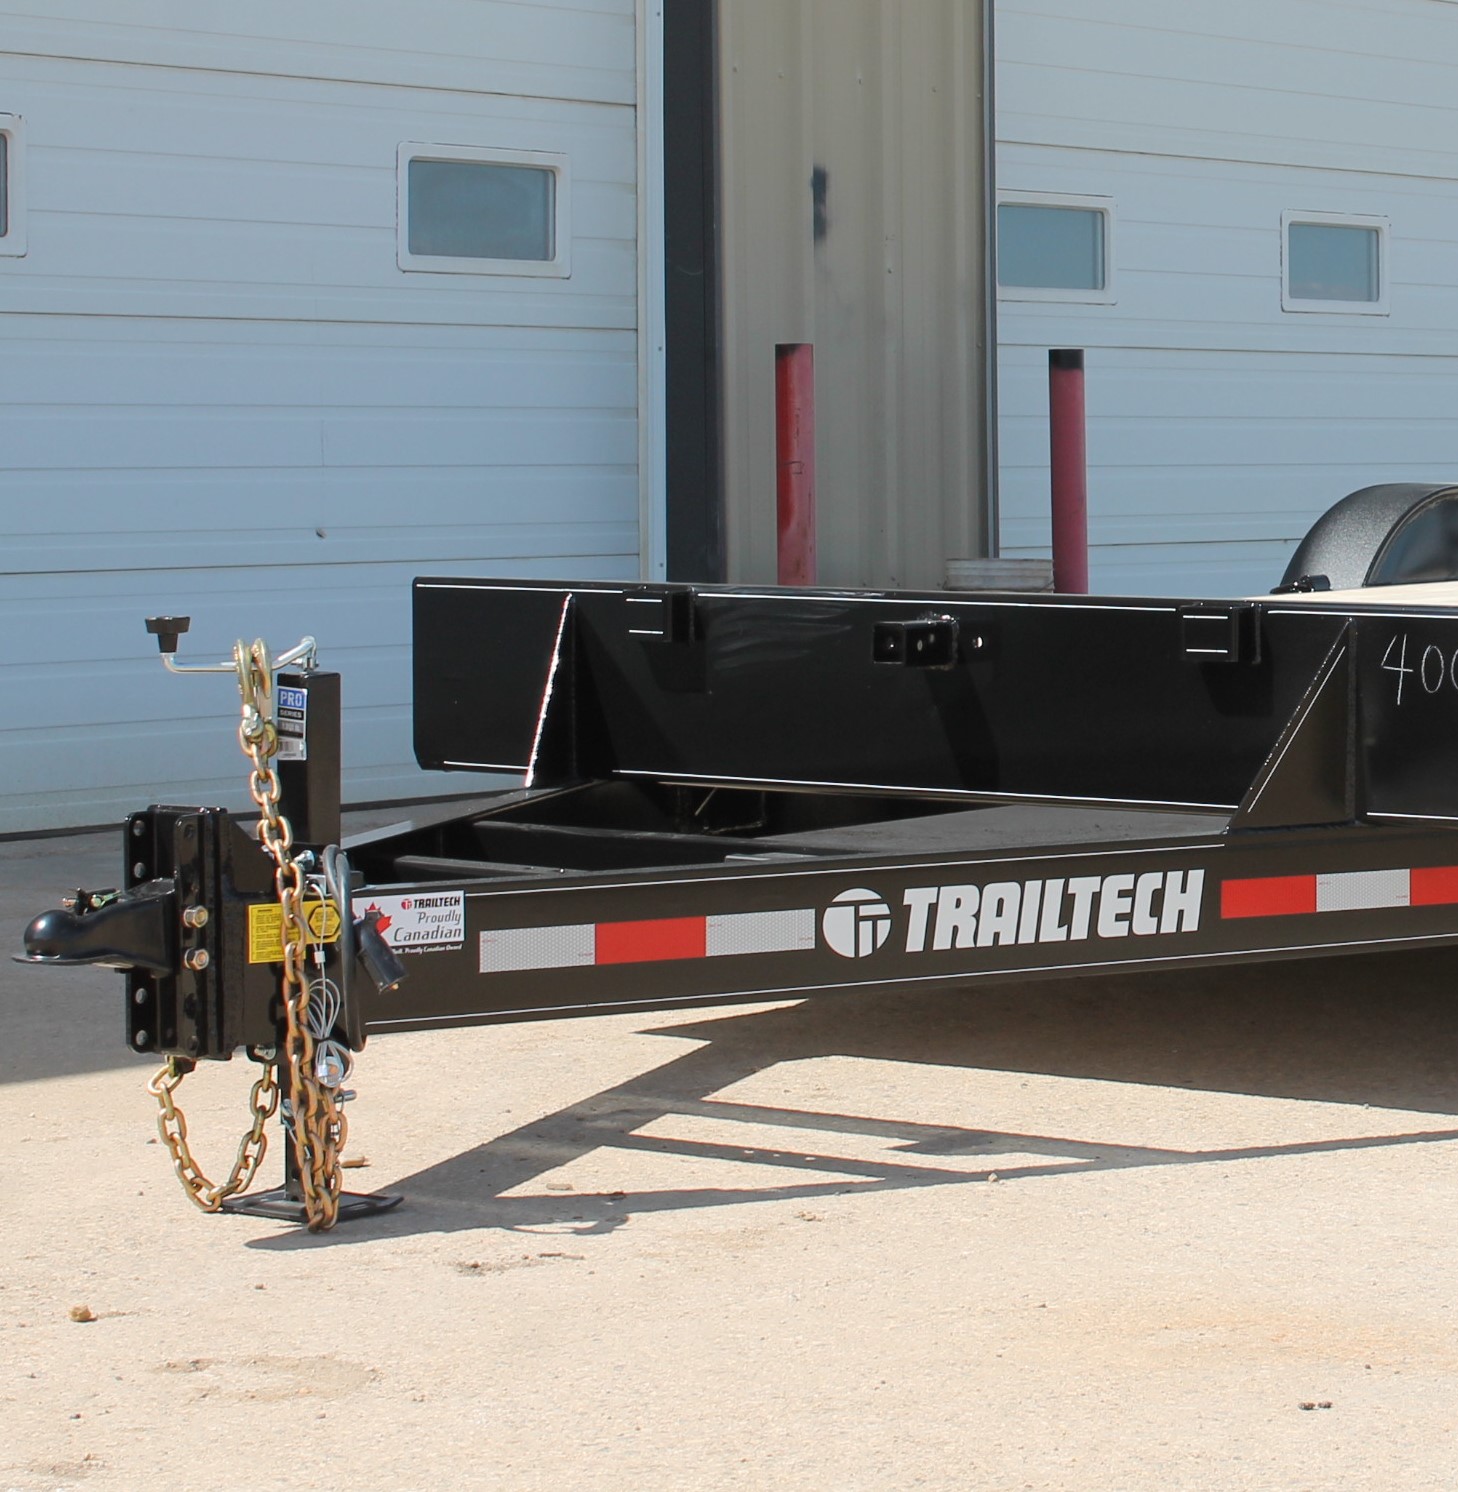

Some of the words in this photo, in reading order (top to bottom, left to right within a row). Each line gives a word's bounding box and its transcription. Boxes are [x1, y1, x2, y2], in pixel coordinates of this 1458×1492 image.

[280, 690, 303, 707] PRO
[414, 896, 461, 909] TRAILTECH
[903, 869, 1205, 953] TRAILTECH
[417, 909, 462, 925] Proudly
[394, 925, 462, 942] Canadian
